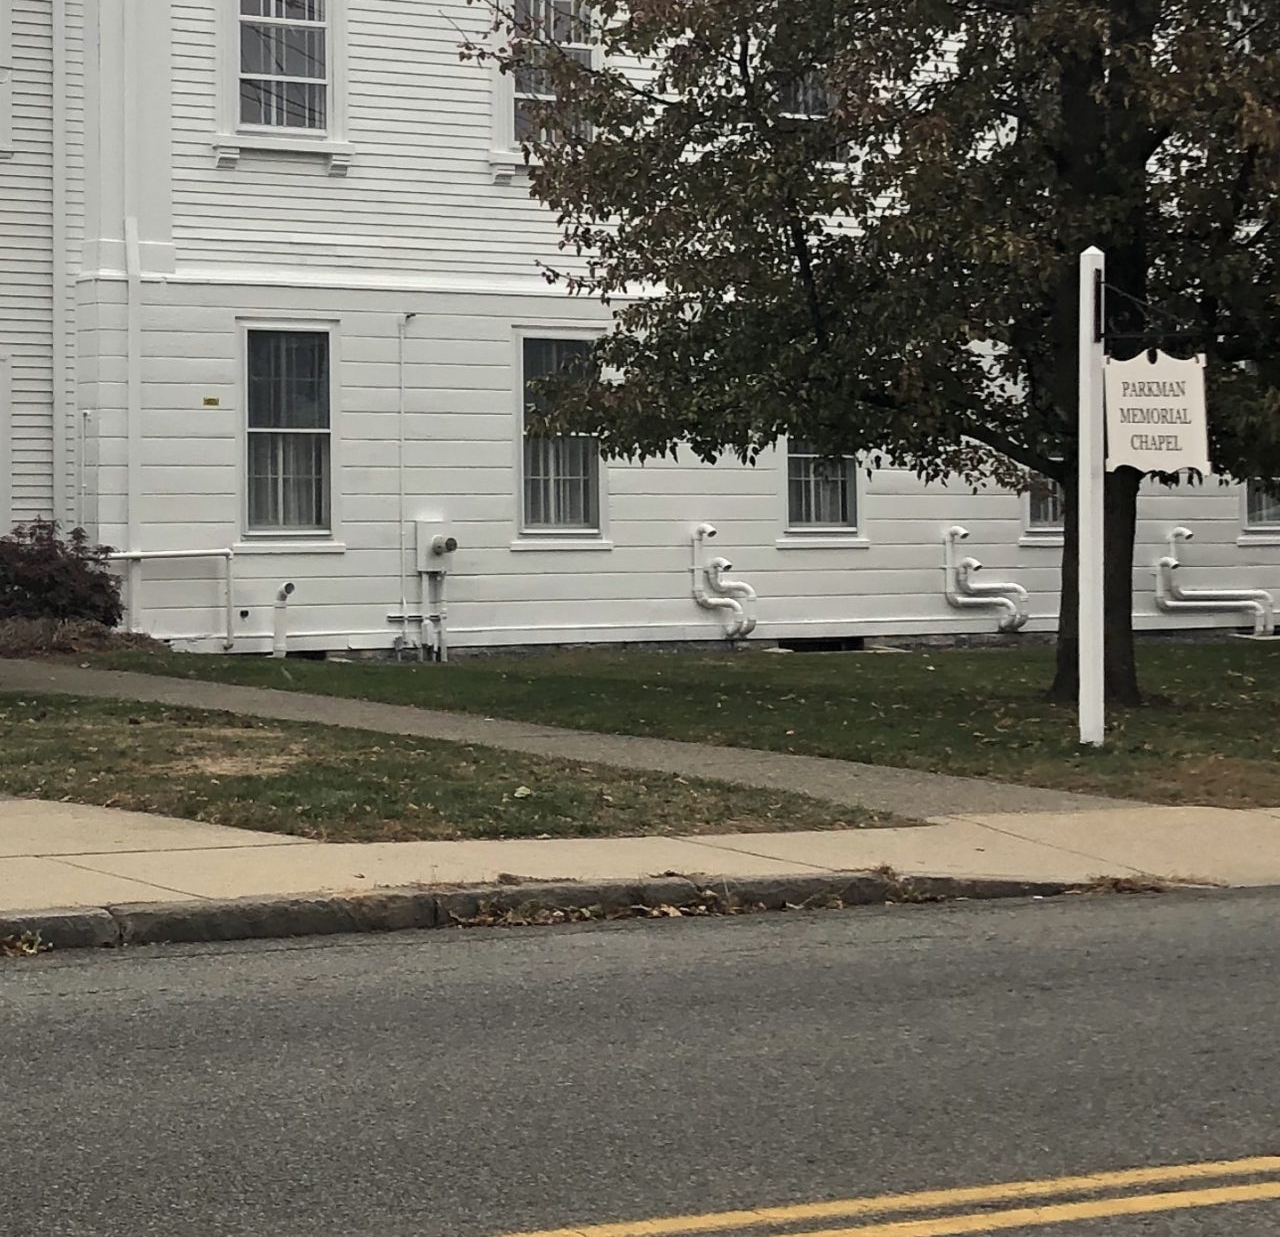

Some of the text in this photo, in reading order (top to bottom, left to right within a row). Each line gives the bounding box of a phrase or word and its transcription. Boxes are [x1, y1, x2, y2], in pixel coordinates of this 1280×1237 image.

[1122, 381, 1186, 397] PARKMAN
[1119, 408, 1192, 424] MEMORIAL
[1130, 434, 1183, 451] CHAPEL
